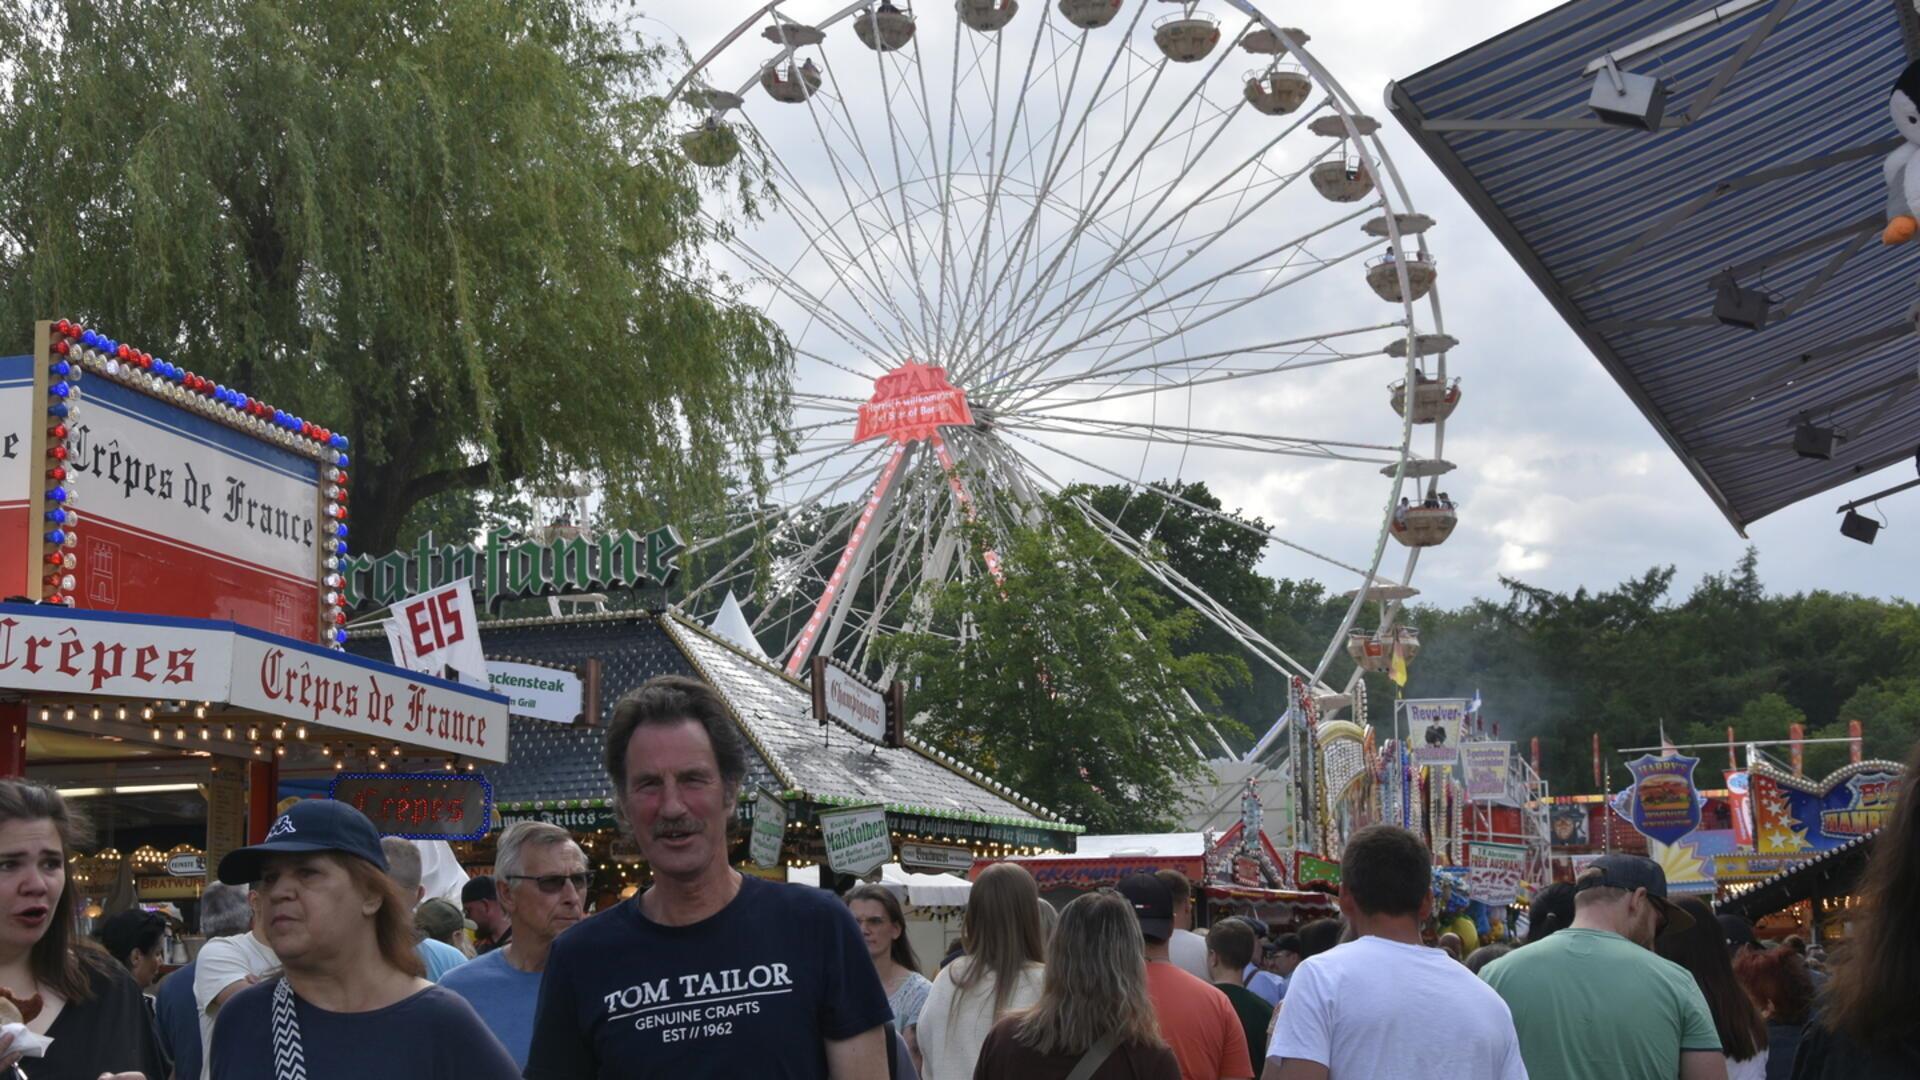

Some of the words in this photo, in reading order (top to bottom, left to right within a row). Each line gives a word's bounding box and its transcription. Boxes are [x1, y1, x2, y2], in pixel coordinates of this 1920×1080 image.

[875, 367, 951, 402] STAR
[67, 422, 173, 500] Crêpes
[183, 462, 213, 515] de
[224, 475, 314, 548] France
[405, 588, 465, 658] EIS
[261, 647, 359, 720] Crêpes
[367, 675, 395, 726] de
[403, 683, 487, 747] France
[488, 671, 565, 693] ackensteak
[517, 697, 537, 709] Grill
[541, 809, 597, 826] Frites
[826, 819, 886, 852] Maiskolben
[604, 978, 671, 1013] TOM
[679, 963, 793, 998] TAILOR
[635, 1004, 701, 1031] GENUINE
[704, 1001, 761, 1021] CRAFTS
[662, 1029, 686, 1043] EST
[688, 1026, 700, 1039] //
[703, 1022, 733, 1037] 1962
